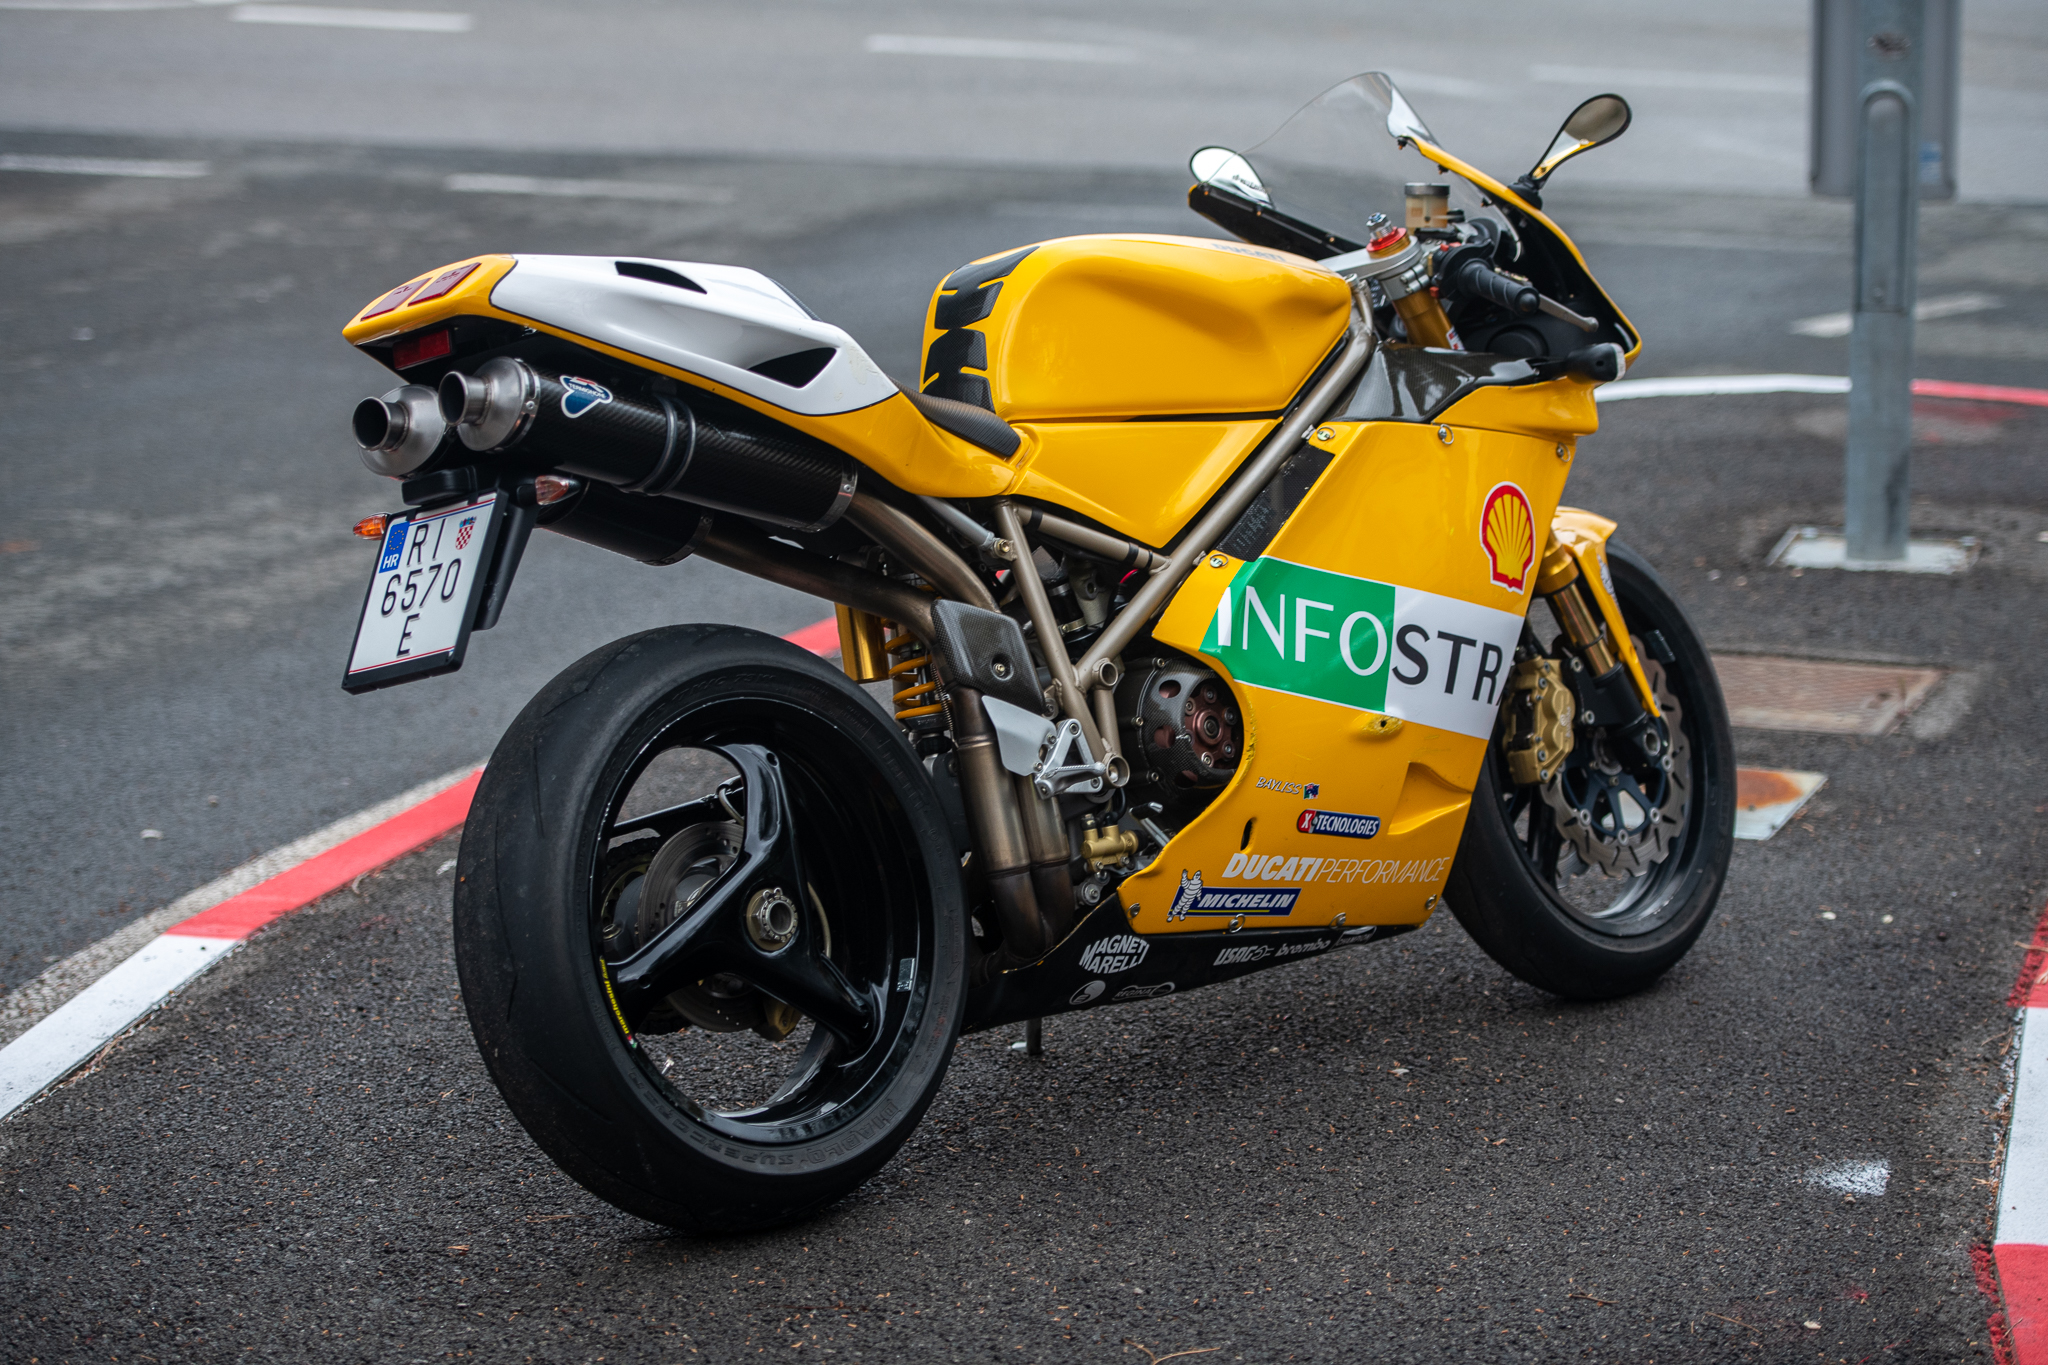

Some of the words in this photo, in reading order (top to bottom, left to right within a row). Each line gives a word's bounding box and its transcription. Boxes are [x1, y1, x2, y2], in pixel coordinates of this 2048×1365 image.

[406, 518, 447, 566] RI
[382, 553, 400, 569] HR
[381, 558, 462, 617] 6570
[396, 613, 420, 658] E
[1216, 585, 1501, 706] INFOSTR
[1256, 776, 1302, 794] BAYLISS
[1316, 814, 1379, 836] TECNOLOGIES
[1197, 892, 1297, 909] MICHELIN
[1274, 938, 1332, 958] brembo
